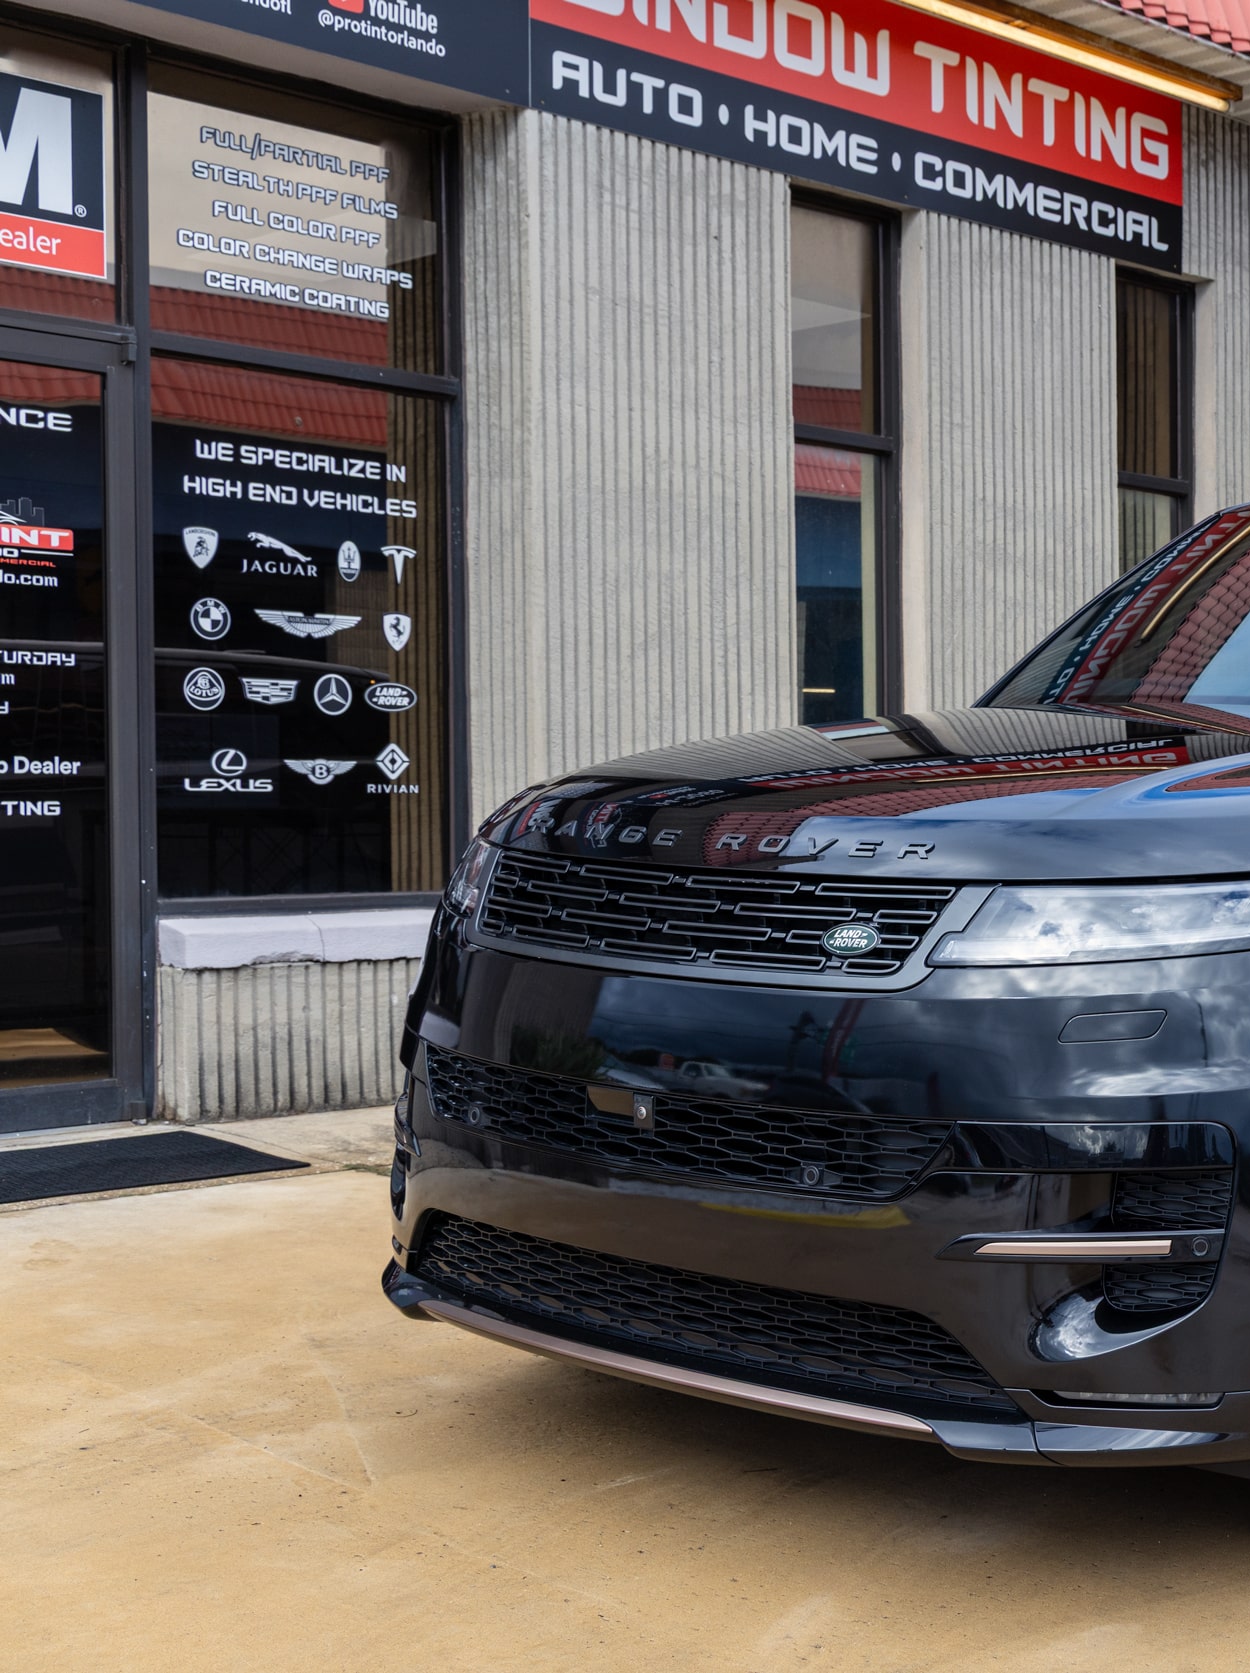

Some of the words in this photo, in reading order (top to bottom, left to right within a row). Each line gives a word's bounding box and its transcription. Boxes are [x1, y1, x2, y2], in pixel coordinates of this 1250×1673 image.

[318, 9, 446, 57] @protintorlando
[369, 0, 438, 34] YouTube
[562, 0, 890, 97] NDOW
[913, 41, 1168, 180] TINTING
[200, 126, 347, 175] FULL/PARTIAL
[350, 160, 390, 183] PPF
[552, 50, 702, 128] AUTO
[744, 103, 878, 175] HOME
[914, 150, 1169, 252] COMMERCIAL
[193, 160, 293, 197] STEALTH
[297, 182, 338, 205] PPF
[342, 194, 398, 219] FILMS
[213, 201, 264, 226] FULL
[269, 212, 337, 241] COLOR
[341, 227, 380, 248] PPF
[177, 229, 250, 257] COLOR
[254, 246, 338, 275] CHANGE
[342, 262, 413, 289] WRAPS
[205, 271, 300, 302] CERAMIC
[304, 288, 389, 318] COATING
[195, 439, 234, 462] WE
[240, 446, 381, 480] SPECIALIZE
[386, 463, 406, 483] IN
[183, 475, 242, 499] HIGH
[248, 482, 298, 505] END
[303, 488, 417, 518] VEHICLES
[0, 569, 58, 587] o.com
[241, 559, 318, 577] JAGUAR
[0, 650, 76, 666] URDAY
[190, 685, 219, 697] LOTUS
[375, 687, 402, 696] LAND
[377, 696, 410, 706] ROVER
[13, 755, 81, 775] Dealer
[184, 778, 273, 792] LEXUS
[367, 783, 419, 794] RIVIAN
[533, 815, 683, 848] RANGE
[715, 833, 936, 860] ROVER
[833, 929, 863, 938] LAND
[833, 938, 867, 948] ROVER
